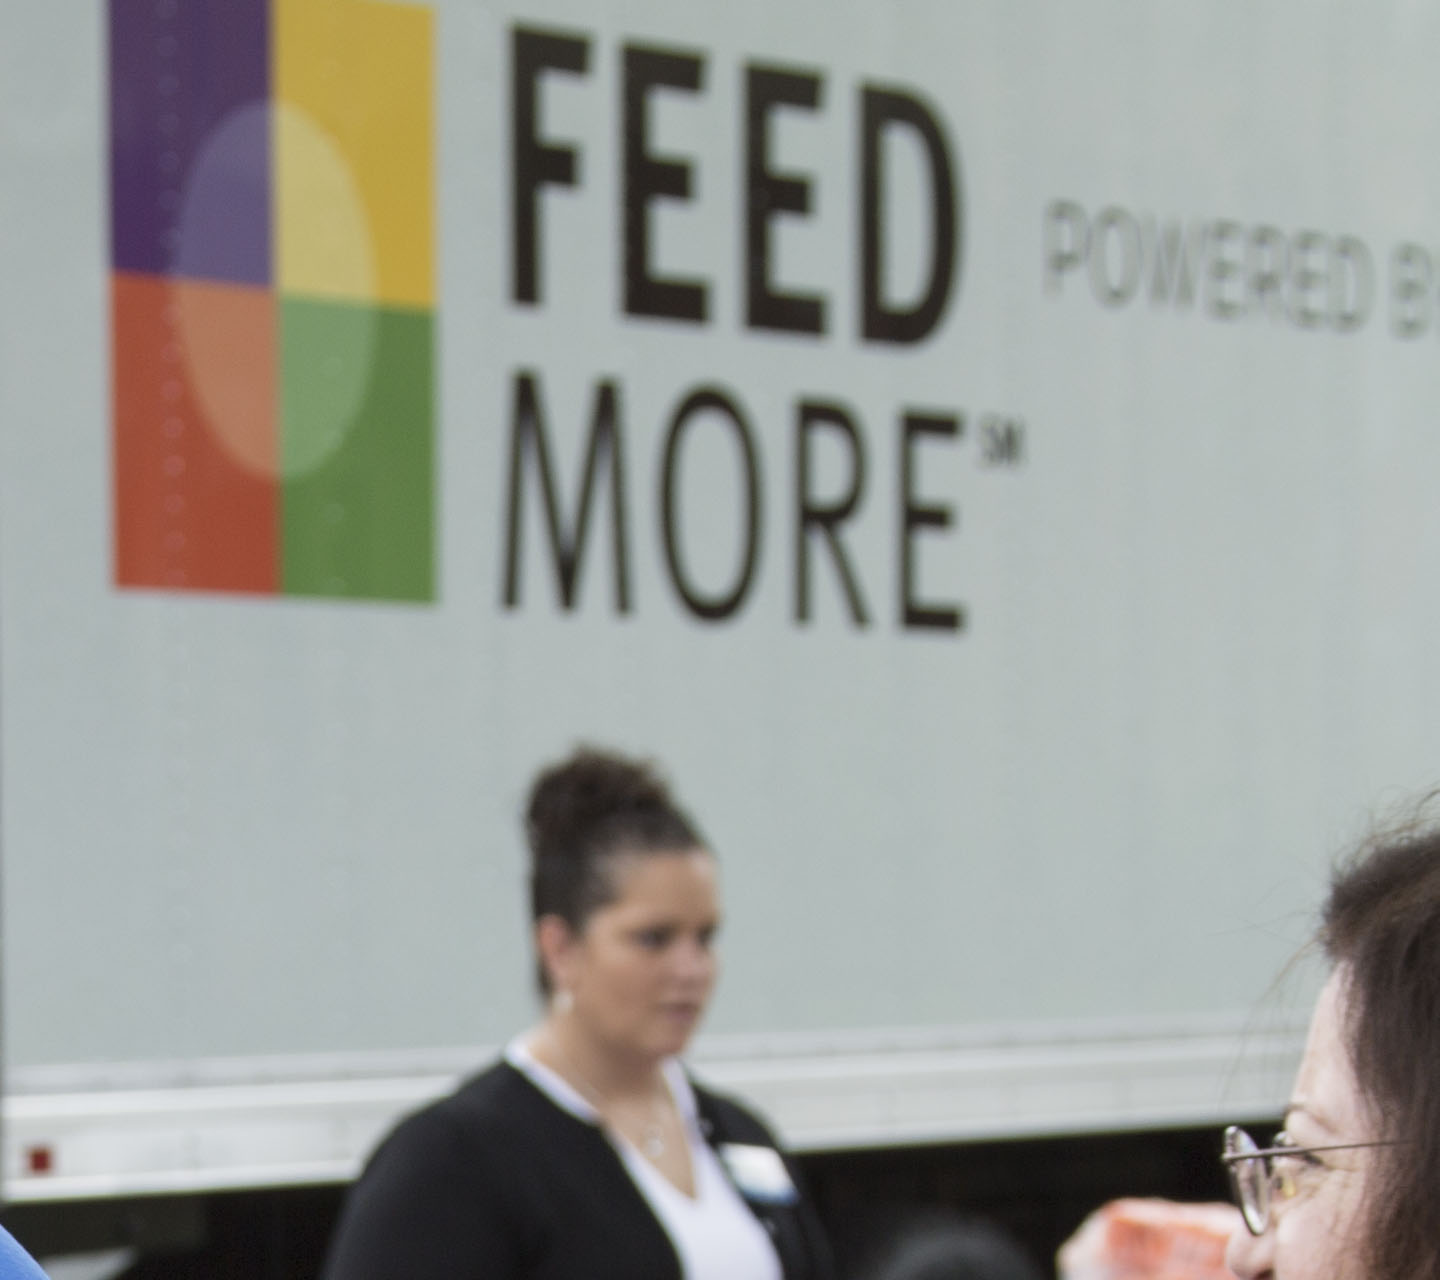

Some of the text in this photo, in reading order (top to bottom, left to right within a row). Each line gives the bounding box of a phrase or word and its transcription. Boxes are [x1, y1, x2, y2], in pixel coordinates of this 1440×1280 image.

[509, 20, 964, 352] FEED
[1042, 199, 1376, 335] POWERED
[501, 366, 969, 637] MORE
